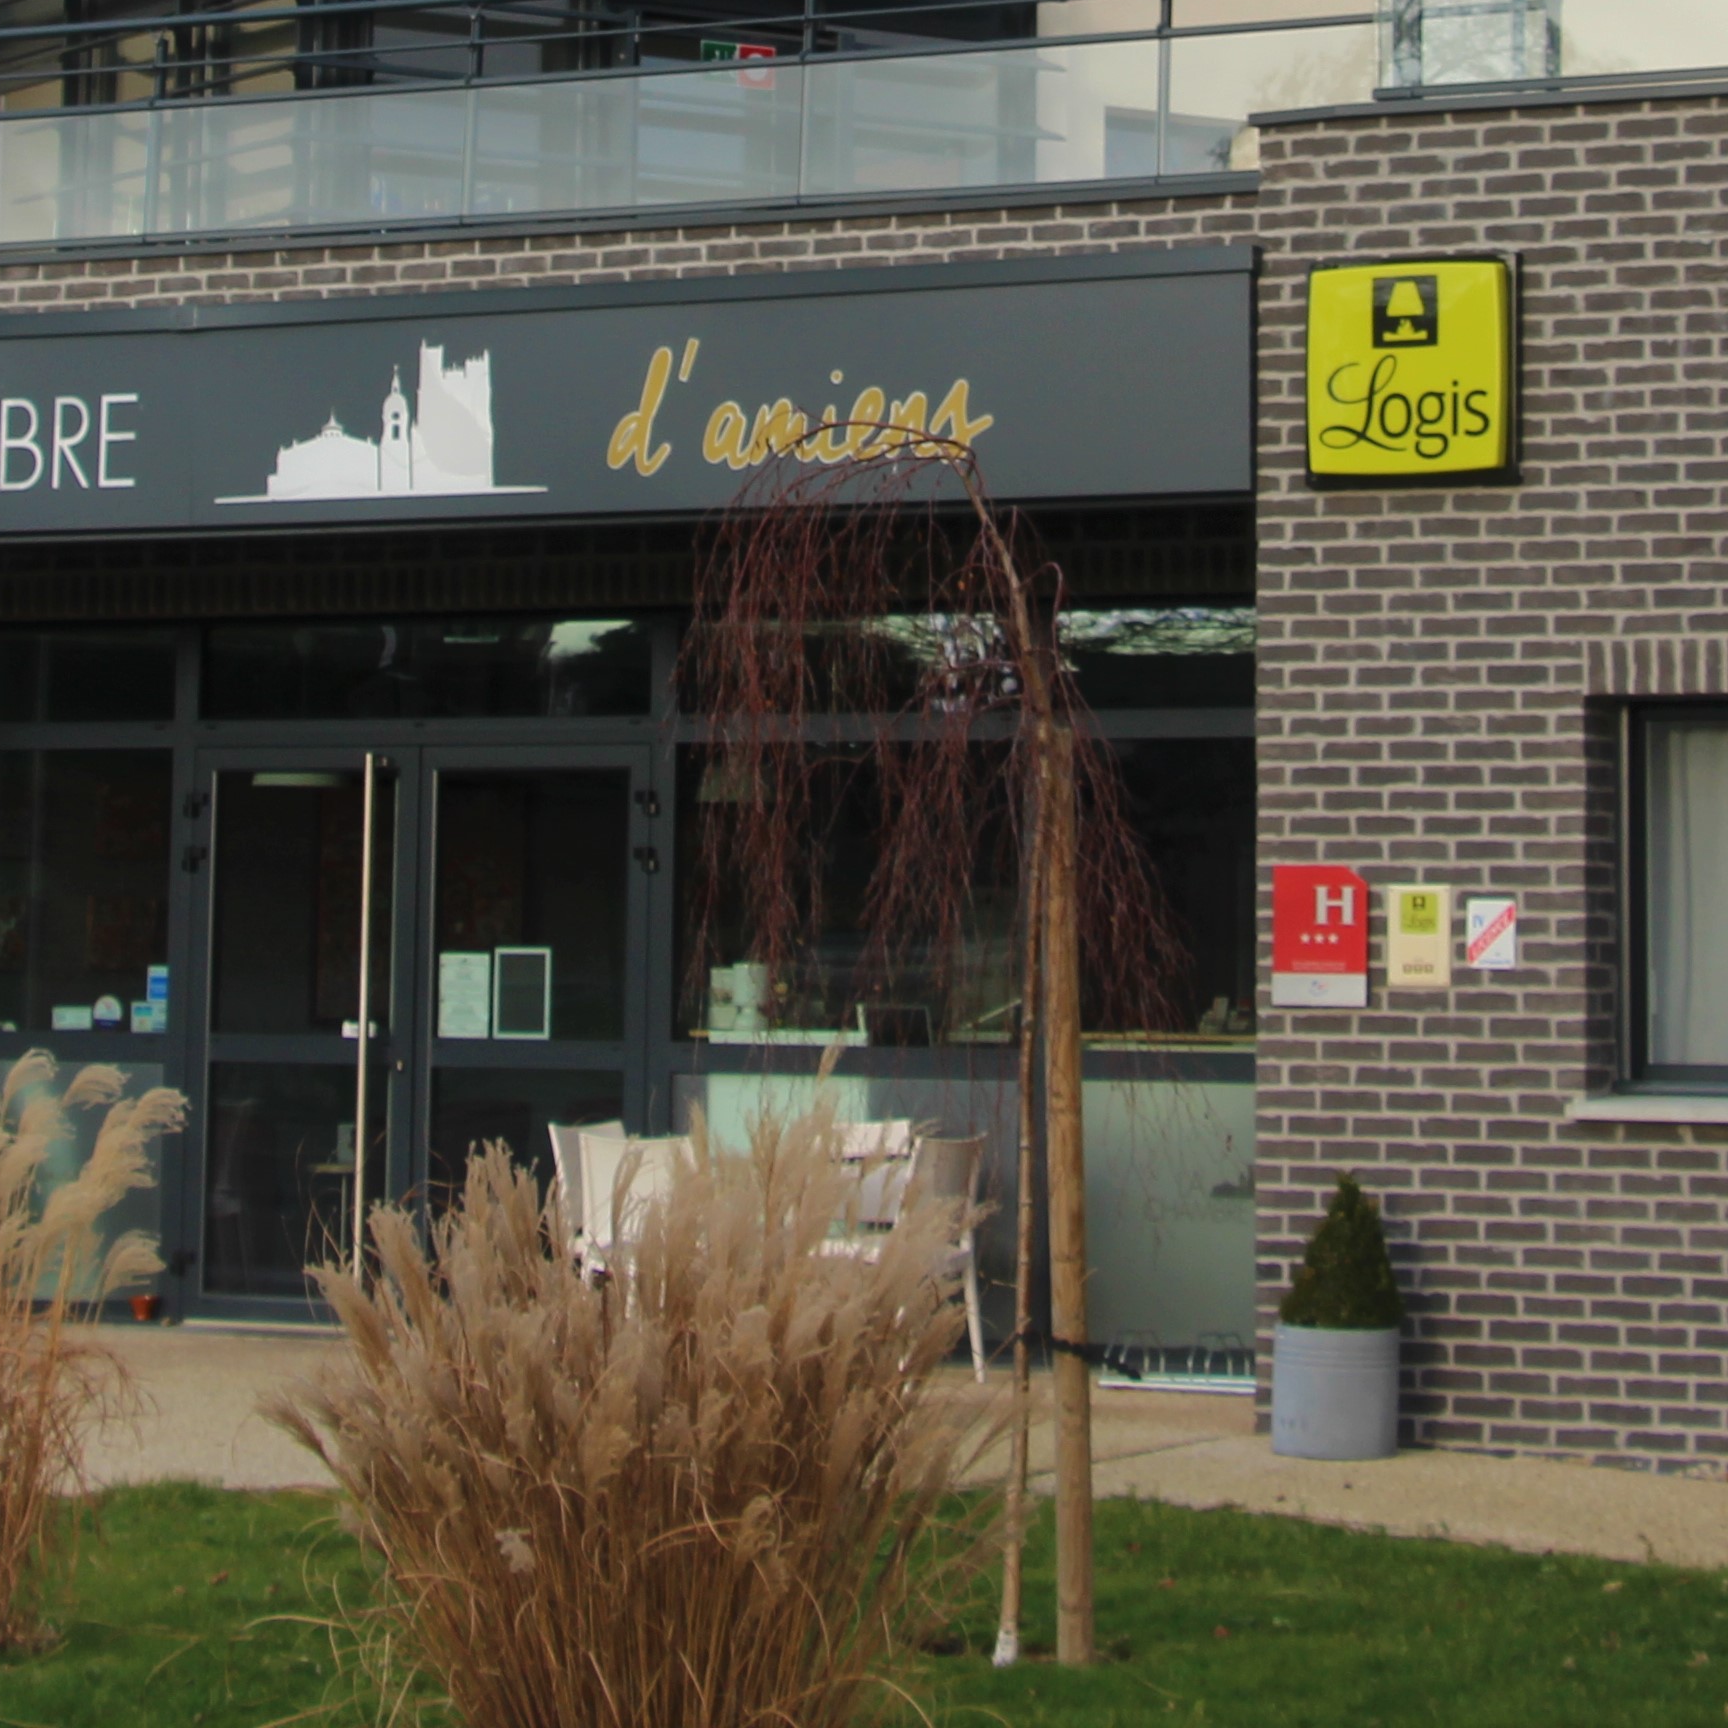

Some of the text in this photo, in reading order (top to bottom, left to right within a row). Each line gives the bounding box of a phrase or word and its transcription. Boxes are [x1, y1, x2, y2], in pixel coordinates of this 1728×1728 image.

[607, 337, 994, 477] d'amiens
[1319, 354, 1491, 460] Logis
[1314, 885, 1355, 926] H
